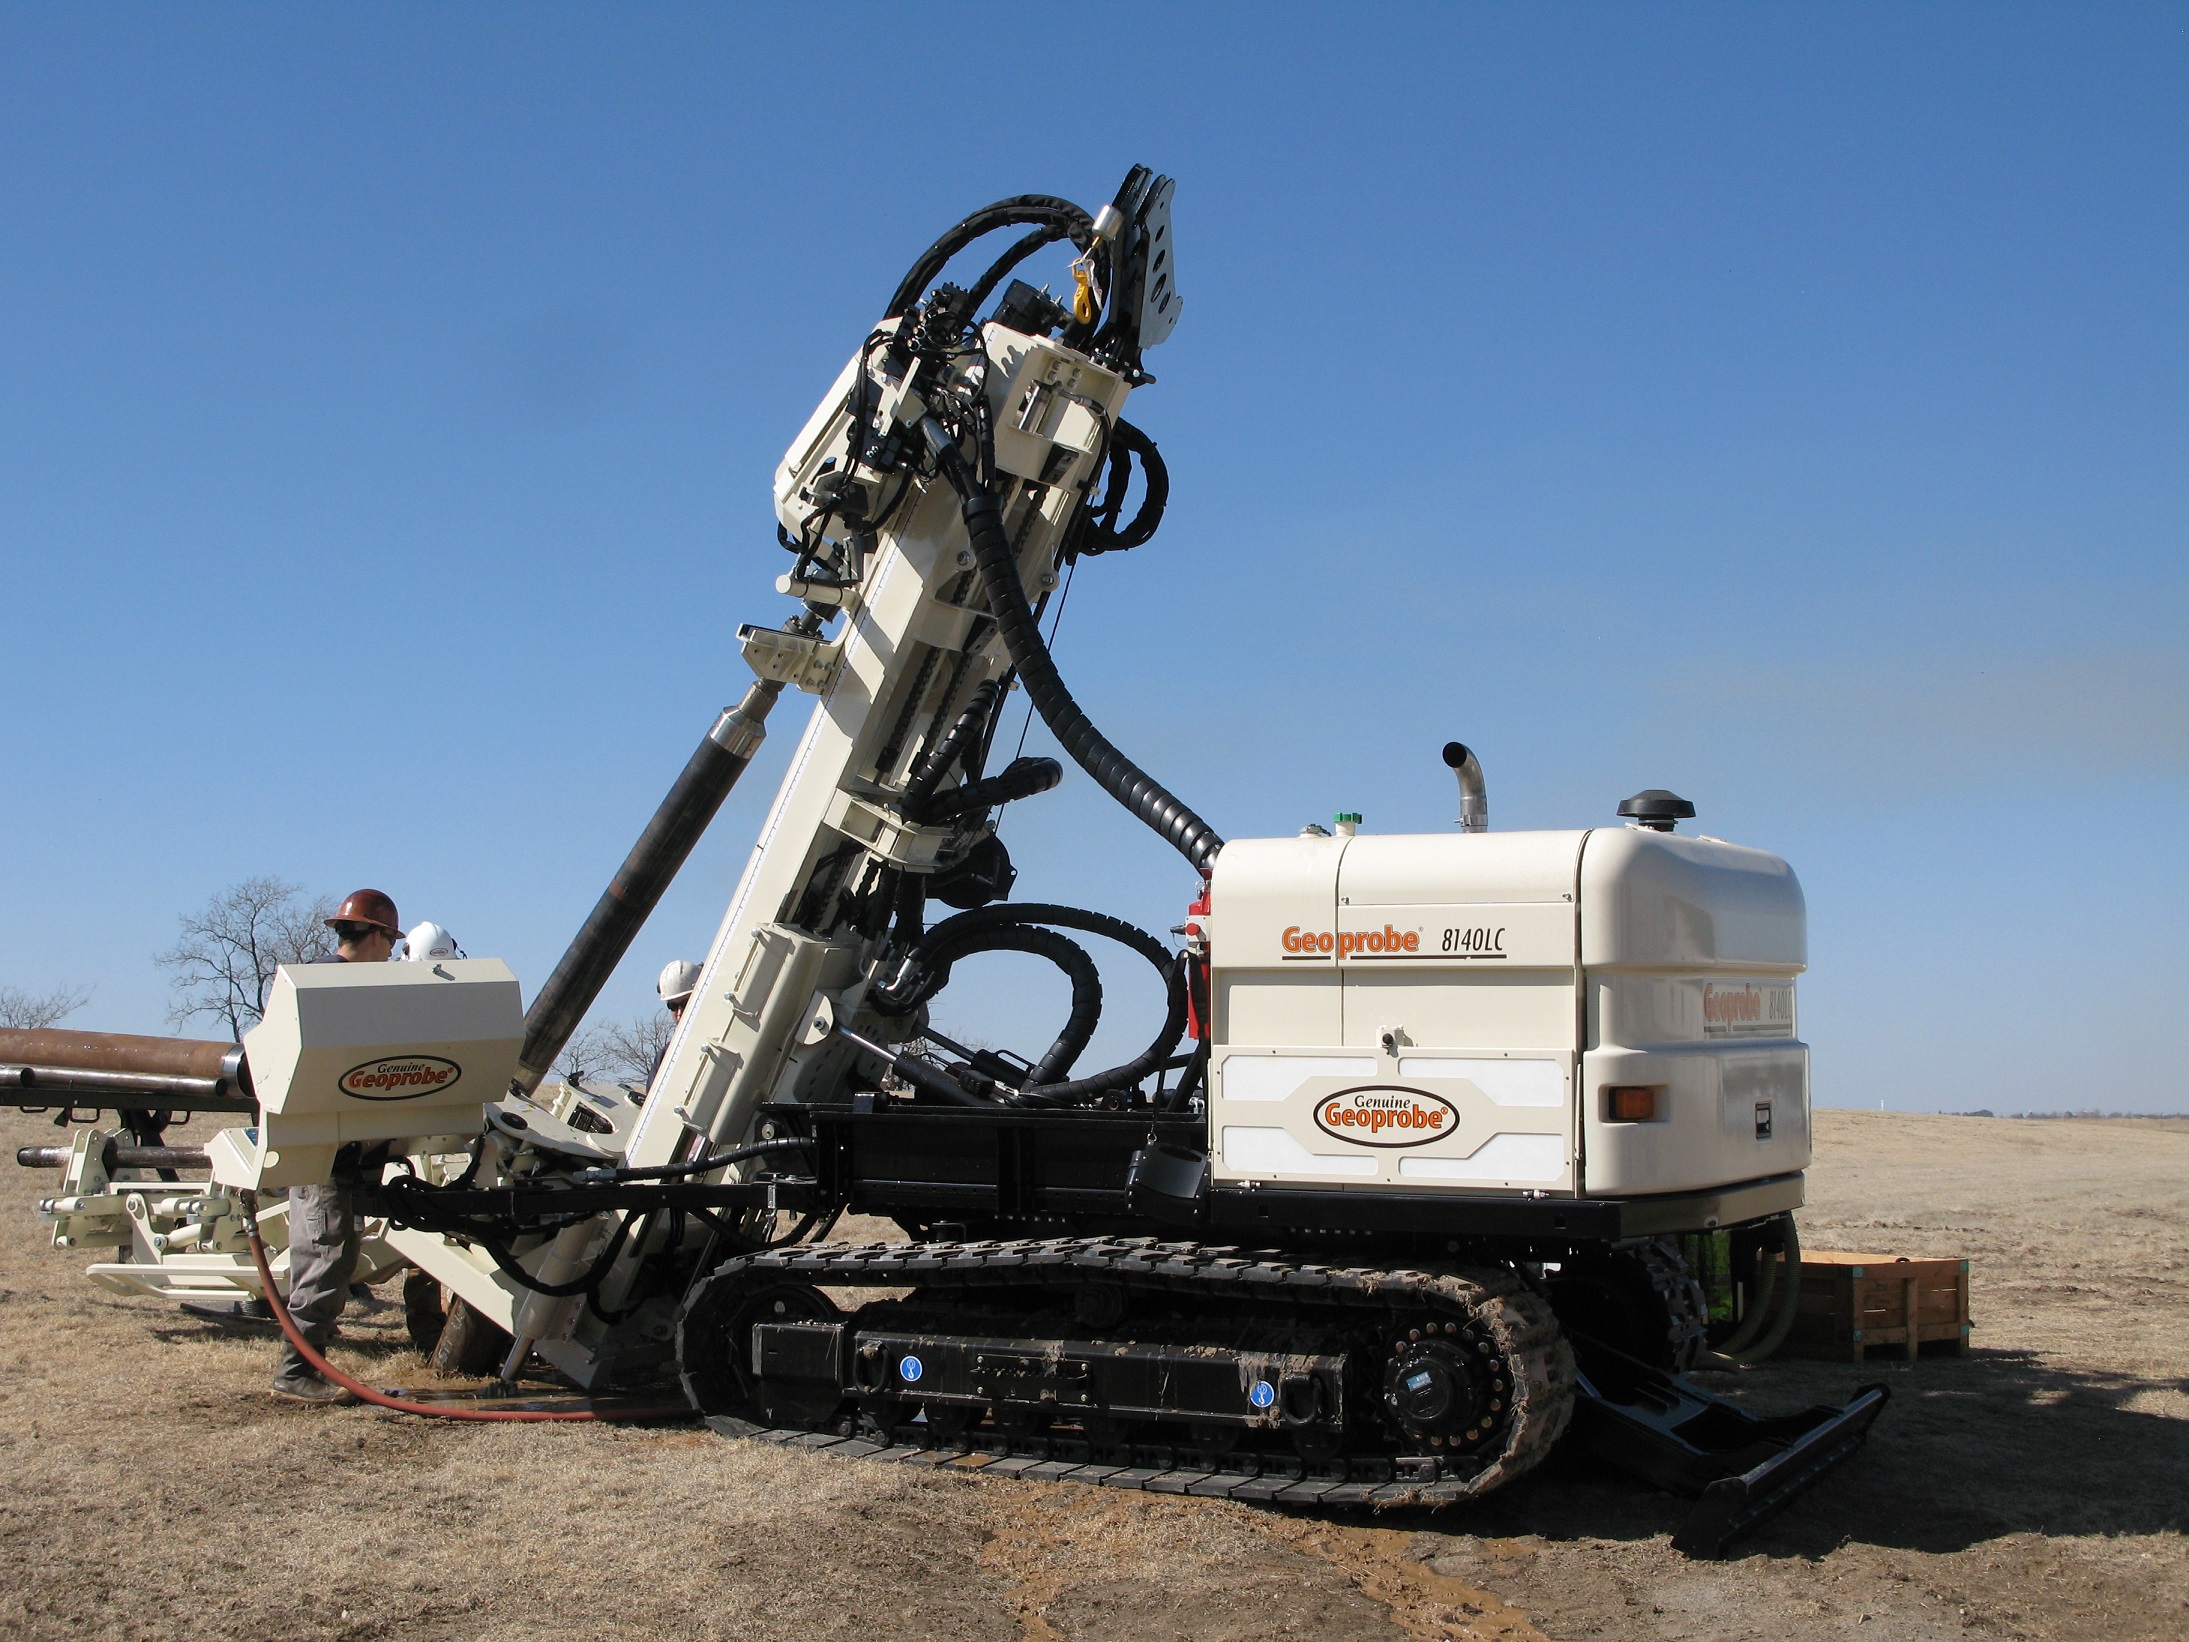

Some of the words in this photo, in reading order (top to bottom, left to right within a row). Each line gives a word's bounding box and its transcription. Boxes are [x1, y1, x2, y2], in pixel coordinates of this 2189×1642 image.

[1442, 928, 1506, 952] 8140LC
[378, 1062, 425, 1074] Genuine
[1354, 1095, 1411, 1109] Genuine
